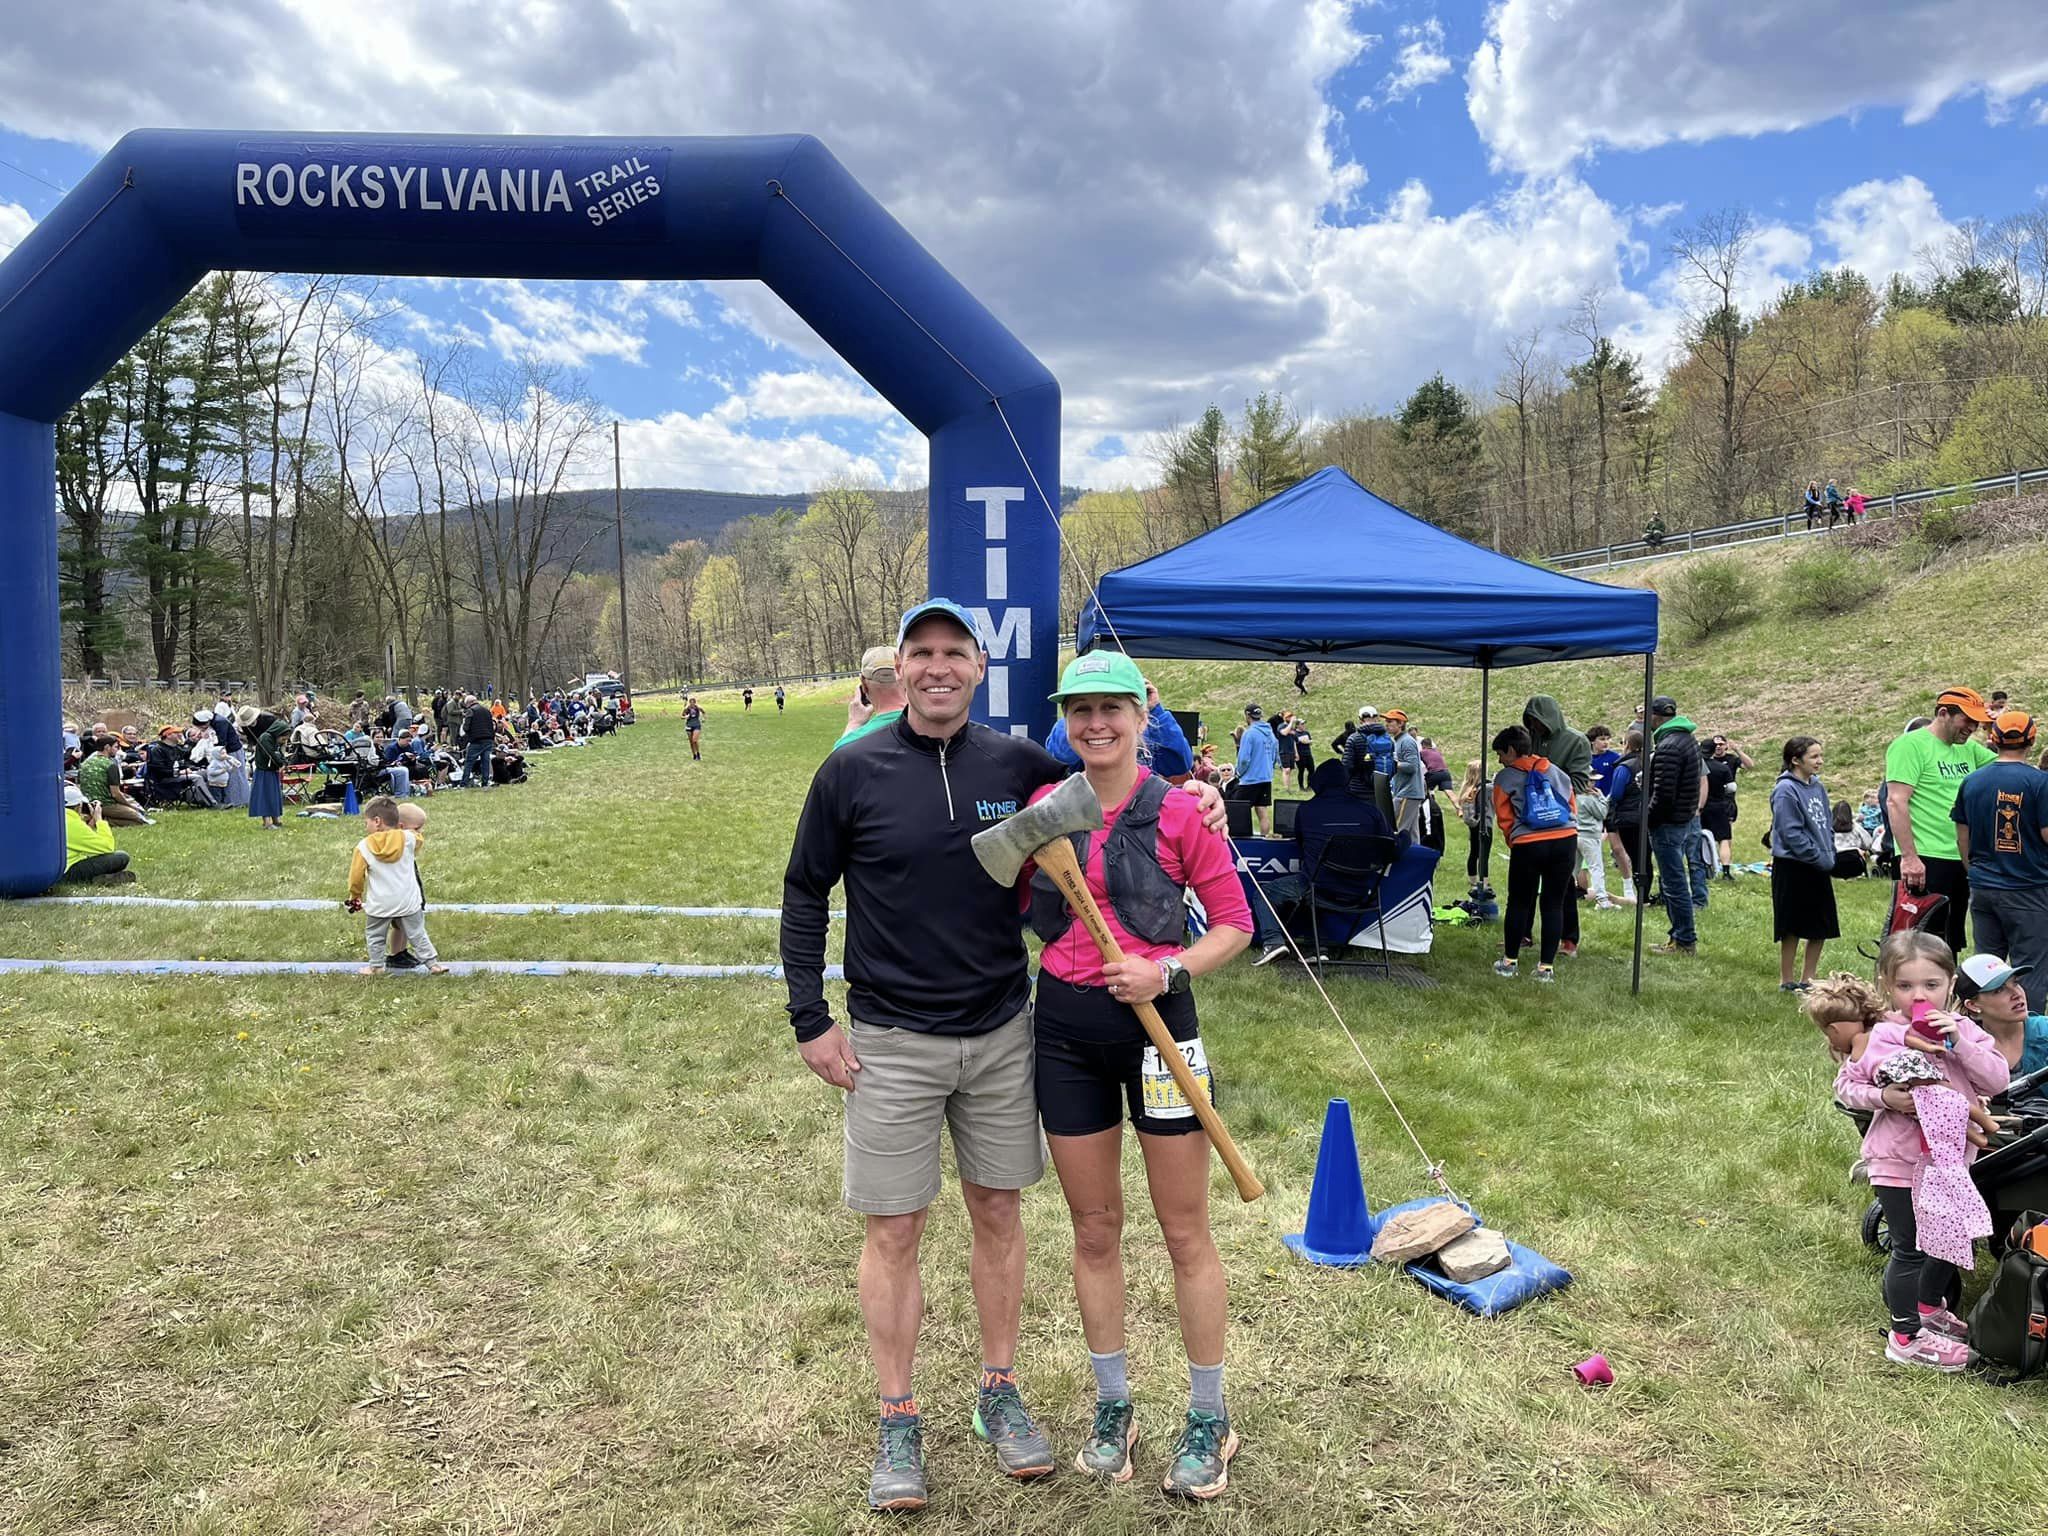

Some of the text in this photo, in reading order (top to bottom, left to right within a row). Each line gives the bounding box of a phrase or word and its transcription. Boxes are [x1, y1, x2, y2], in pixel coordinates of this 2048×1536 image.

[236, 163, 574, 212] ROCKSYLVANIA
[575, 156, 650, 198] TRAIL
[587, 175, 661, 226] SERIES
[965, 487, 1031, 738] TIMI
[976, 800, 1017, 820] HYNER
